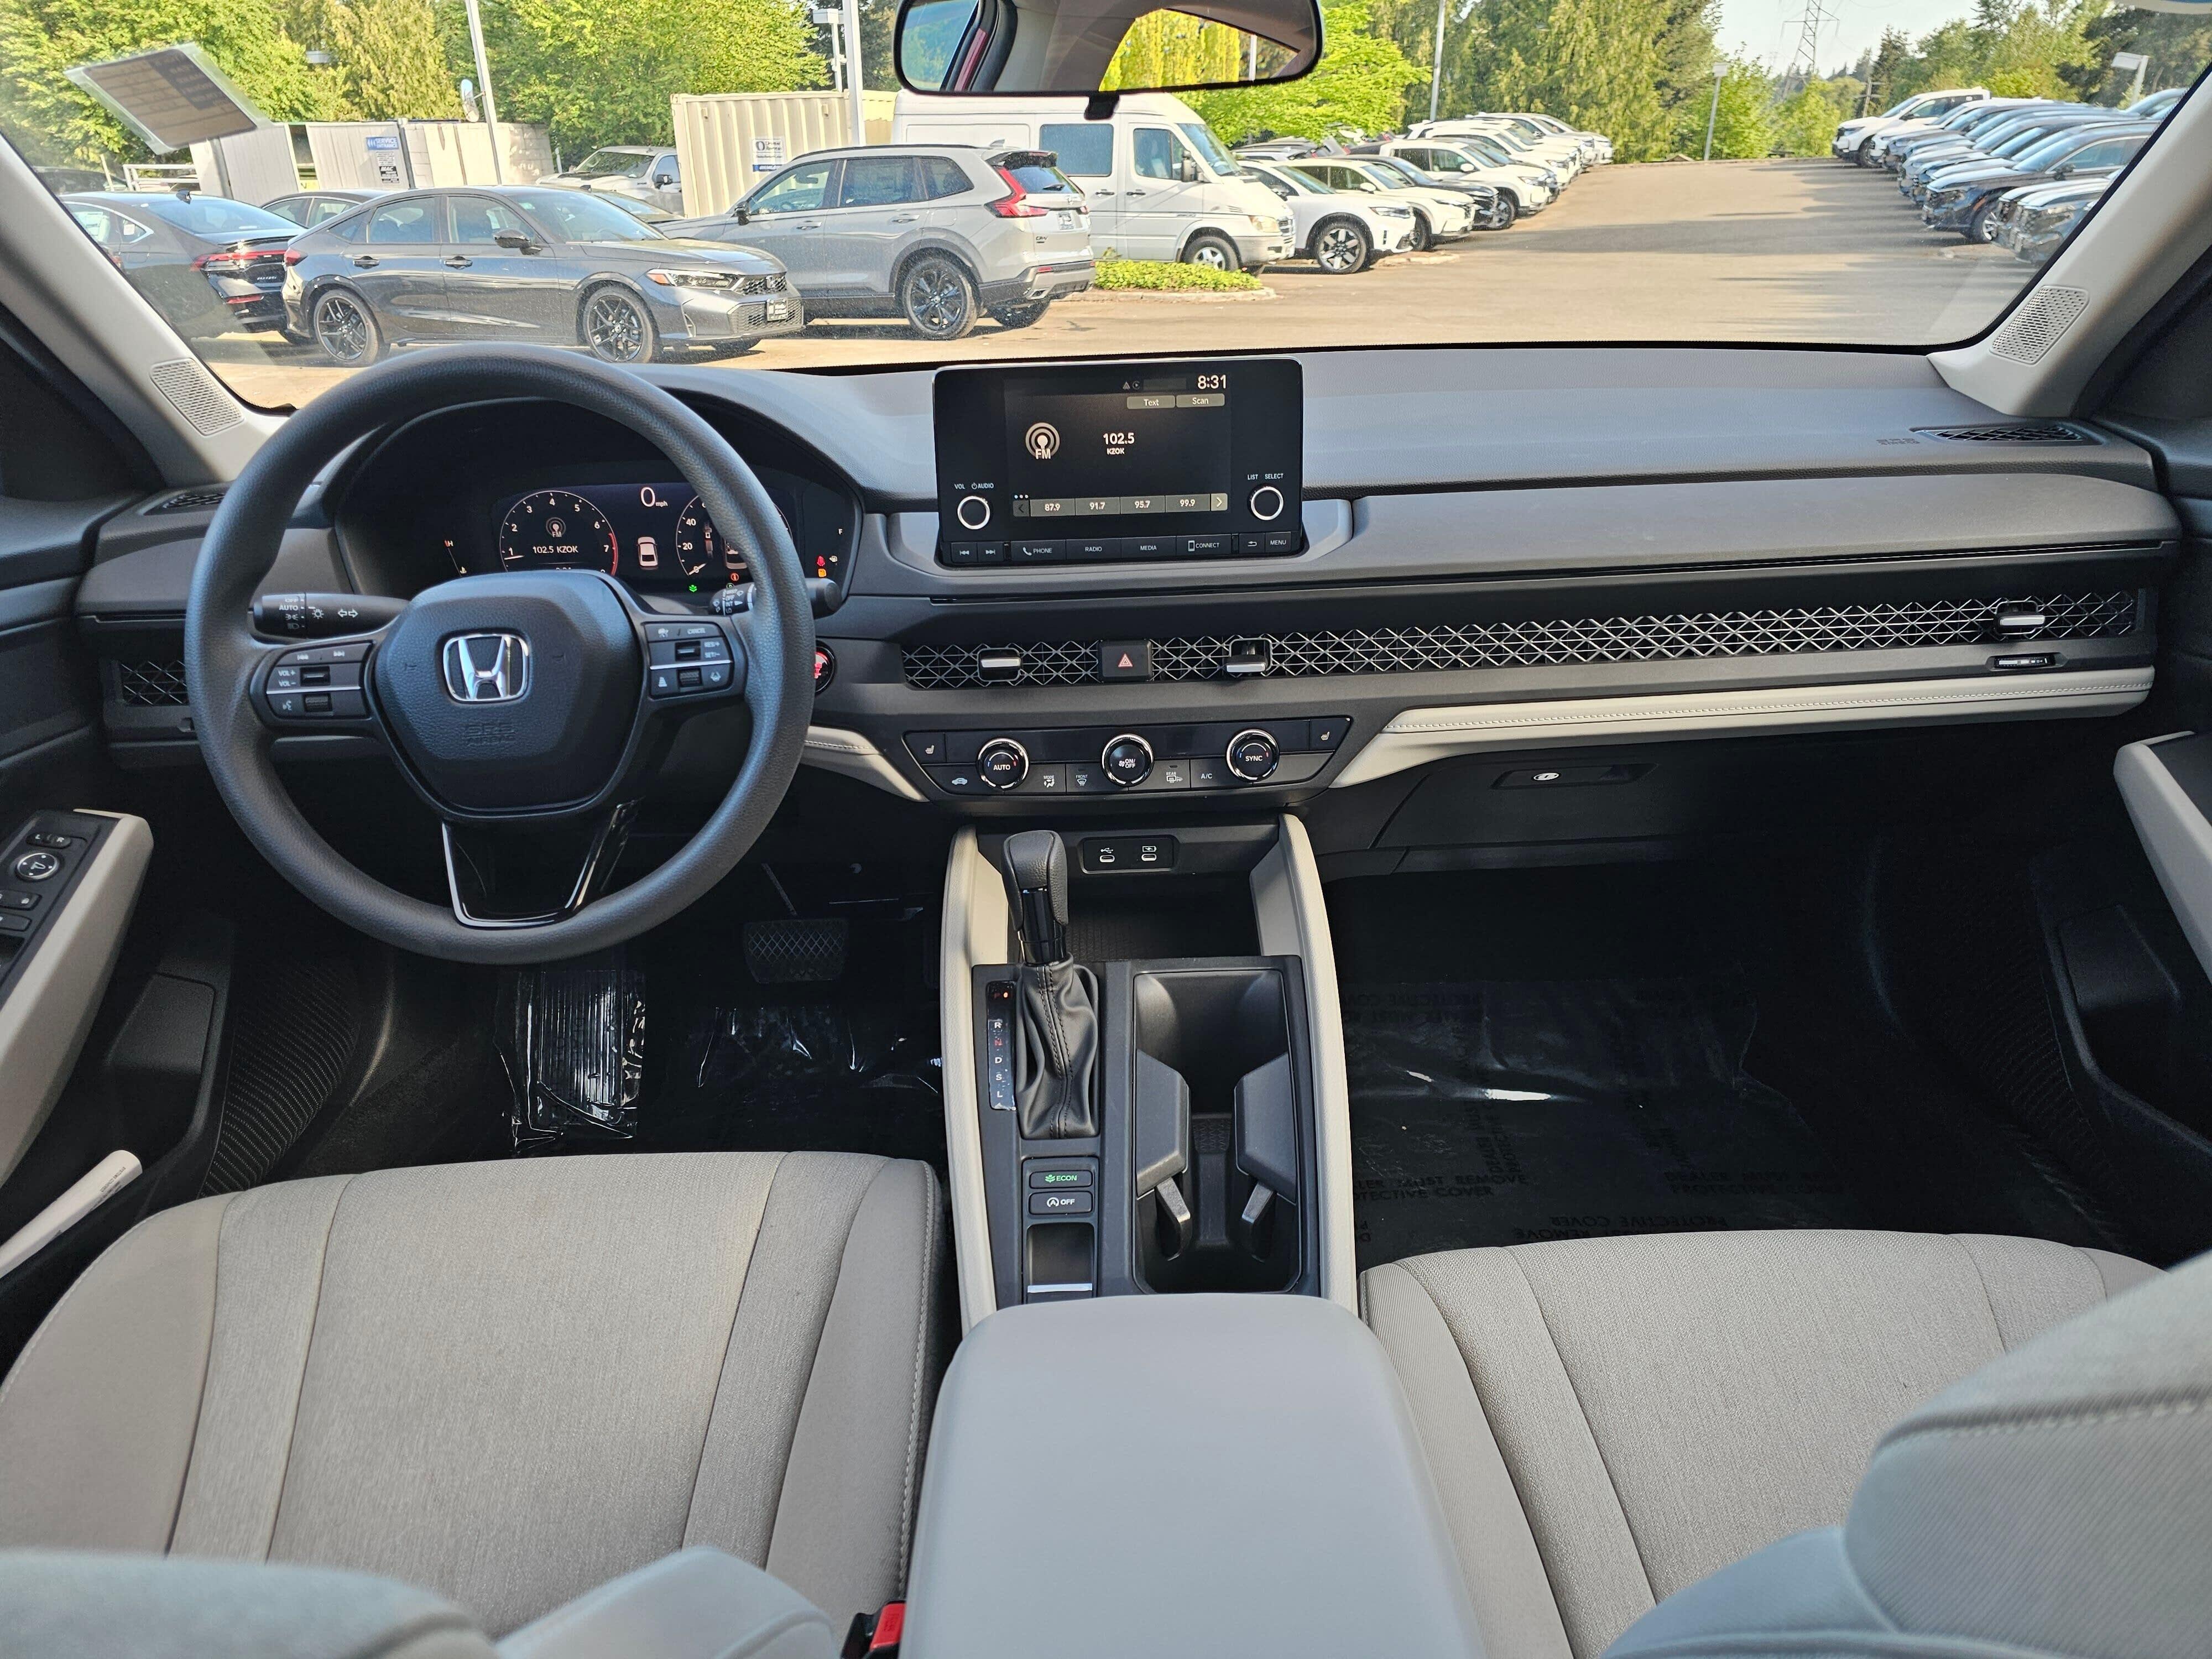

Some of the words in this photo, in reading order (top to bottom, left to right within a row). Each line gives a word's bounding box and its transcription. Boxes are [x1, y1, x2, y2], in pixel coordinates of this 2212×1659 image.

[1197, 374, 1226, 389] 8:31
[1144, 398, 1159, 406] Text
[1103, 432, 1135, 445] 102.5
[1035, 448, 1051, 460] FM
[640, 487, 655, 507] 0
[1044, 503, 1061, 512] 87.9
[1089, 502, 1105, 510] 91.7
[1134, 500, 1151, 509] 95.7
[1180, 499, 1196, 507] 99.9
[575, 504, 580, 512] 5
[509, 547, 513, 555] 1
[1436, 1186, 1494, 1198] COVER
